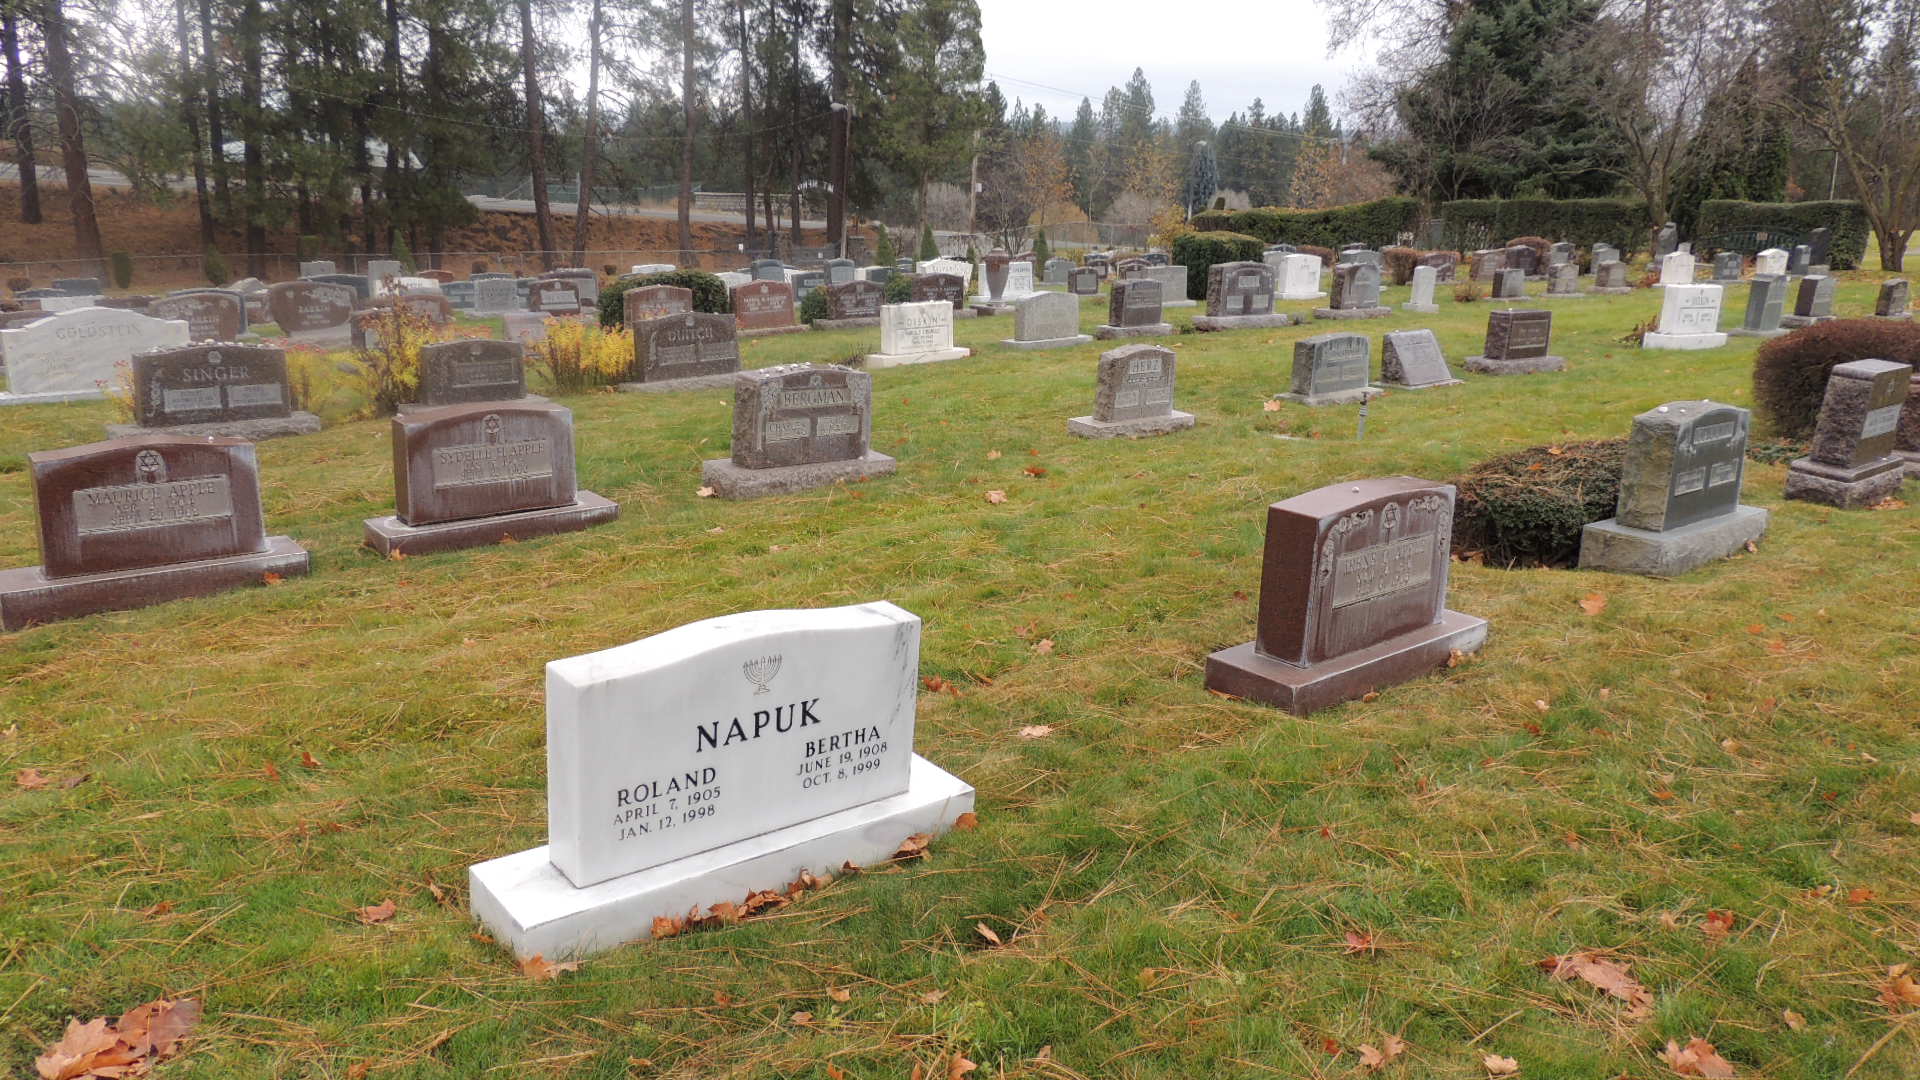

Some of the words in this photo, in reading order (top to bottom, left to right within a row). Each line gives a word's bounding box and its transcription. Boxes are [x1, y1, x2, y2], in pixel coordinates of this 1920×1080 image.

[55, 323, 143, 340] GOLDSTEIN
[182, 366, 250, 382] SINGER
[784, 389, 844, 407] BERGMAN
[510, 443, 545, 458] APPLE
[87, 486, 161, 505] MAURICE
[168, 481, 216, 499] APPLE
[696, 698, 821, 752] NAPUK
[805, 726, 881, 758] BERTHA
[796, 757, 832, 775] JUNE
[839, 751, 854, 766] 19,
[859, 741, 888, 759] 1908
[802, 771, 832, 789] OCT.
[837, 767, 848, 780] 8,
[853, 758, 881, 776] 1999
[617, 767, 717, 807] ROLAND
[613, 804, 659, 825] APRIL
[669, 799, 679, 811] 7,
[687, 786, 721, 806] 1905
[618, 823, 652, 841] JAN.
[659, 816, 676, 831] 12,
[683, 804, 716, 824] 1998
